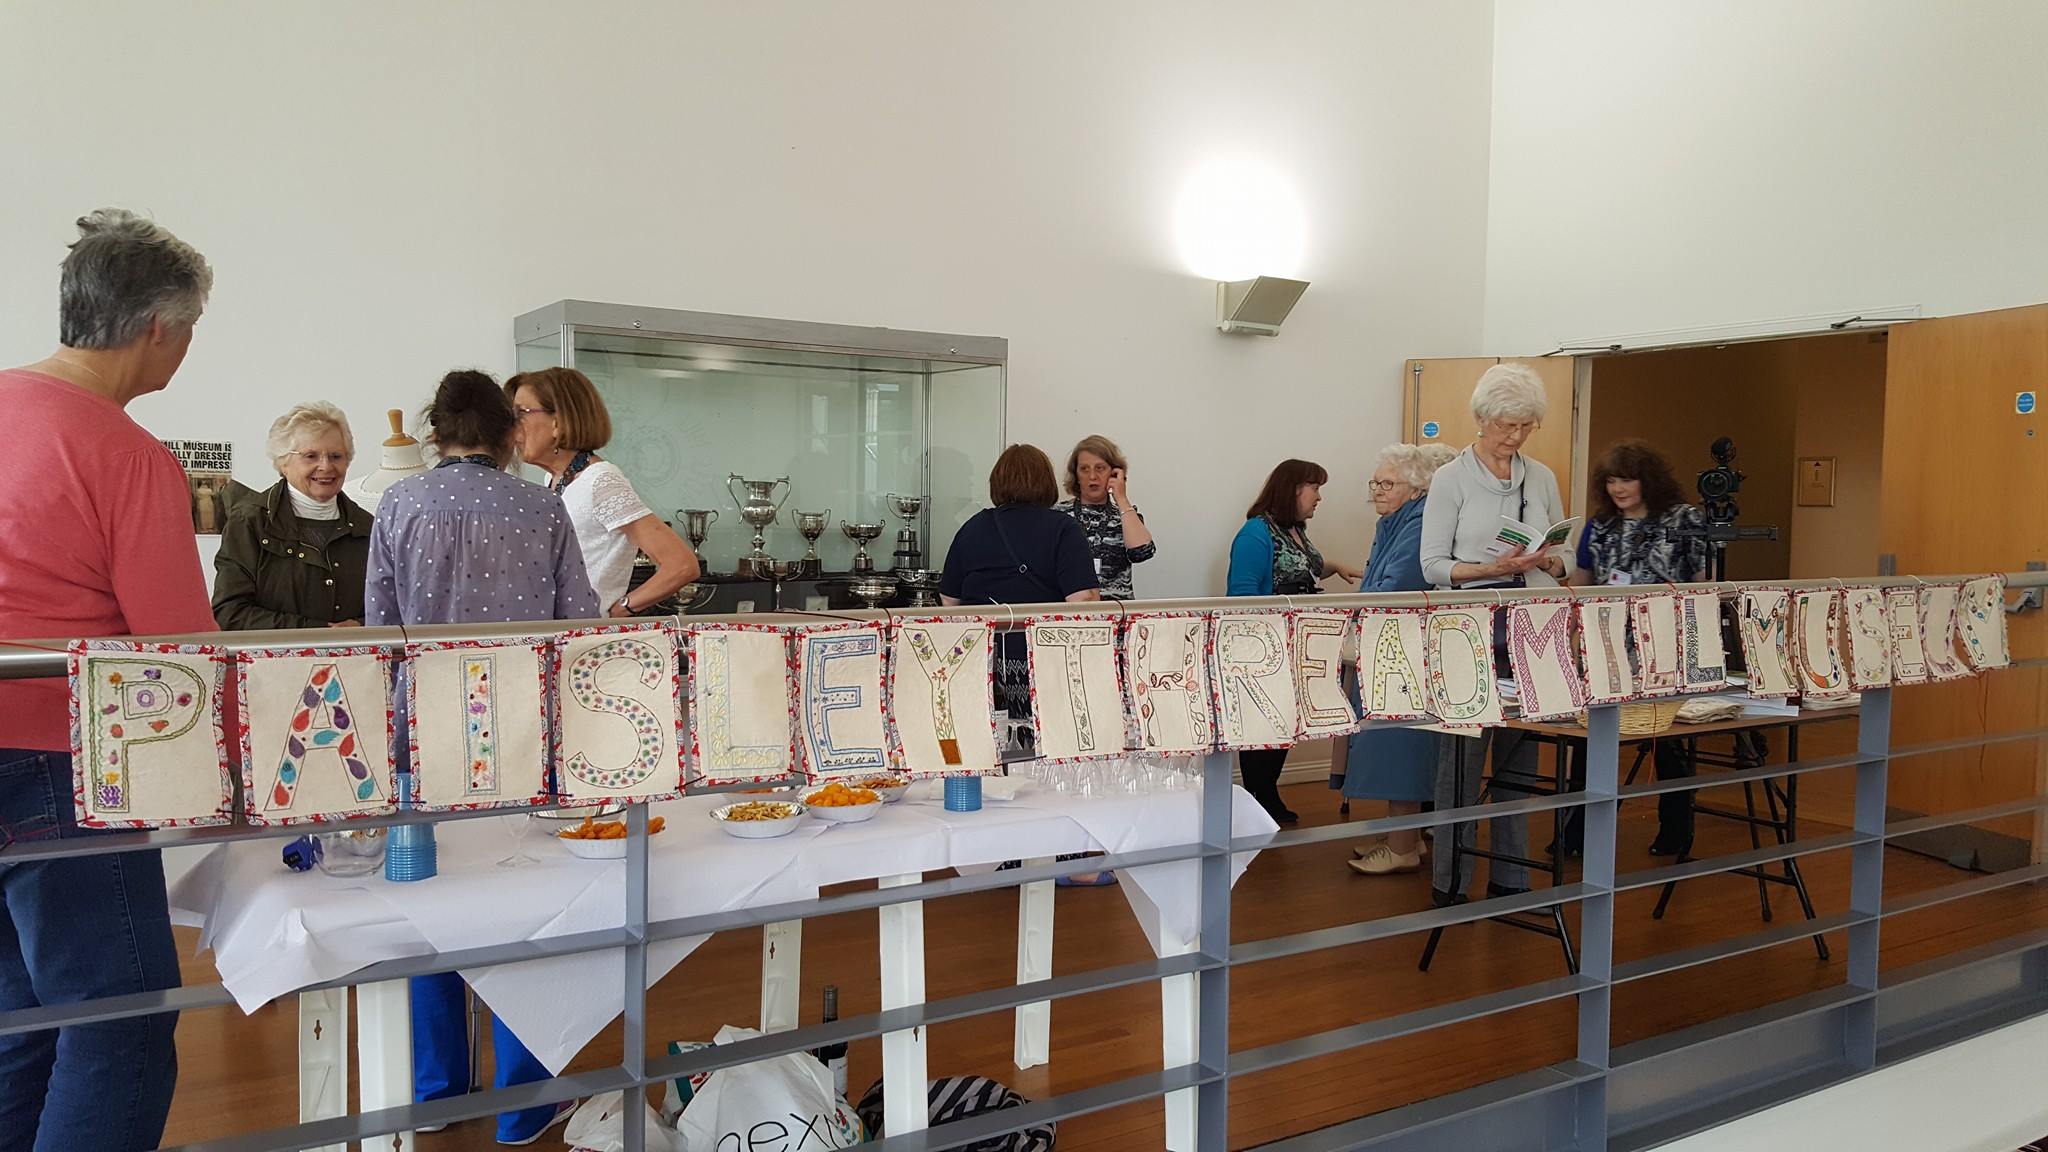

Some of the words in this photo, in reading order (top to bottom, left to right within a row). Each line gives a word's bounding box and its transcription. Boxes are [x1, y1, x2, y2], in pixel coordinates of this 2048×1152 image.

[183, 441, 222, 452] MUSEUM
[225, 443, 232, 452] IS
[173, 450, 191, 460] ALLY
[191, 460, 230, 470] IMPRESS
[88, 628, 986, 813] PAISLEY
[1036, 614, 1489, 751] THREAD
[1513, 598, 1724, 713] MILL
[1744, 579, 2009, 690] MUSEUM
